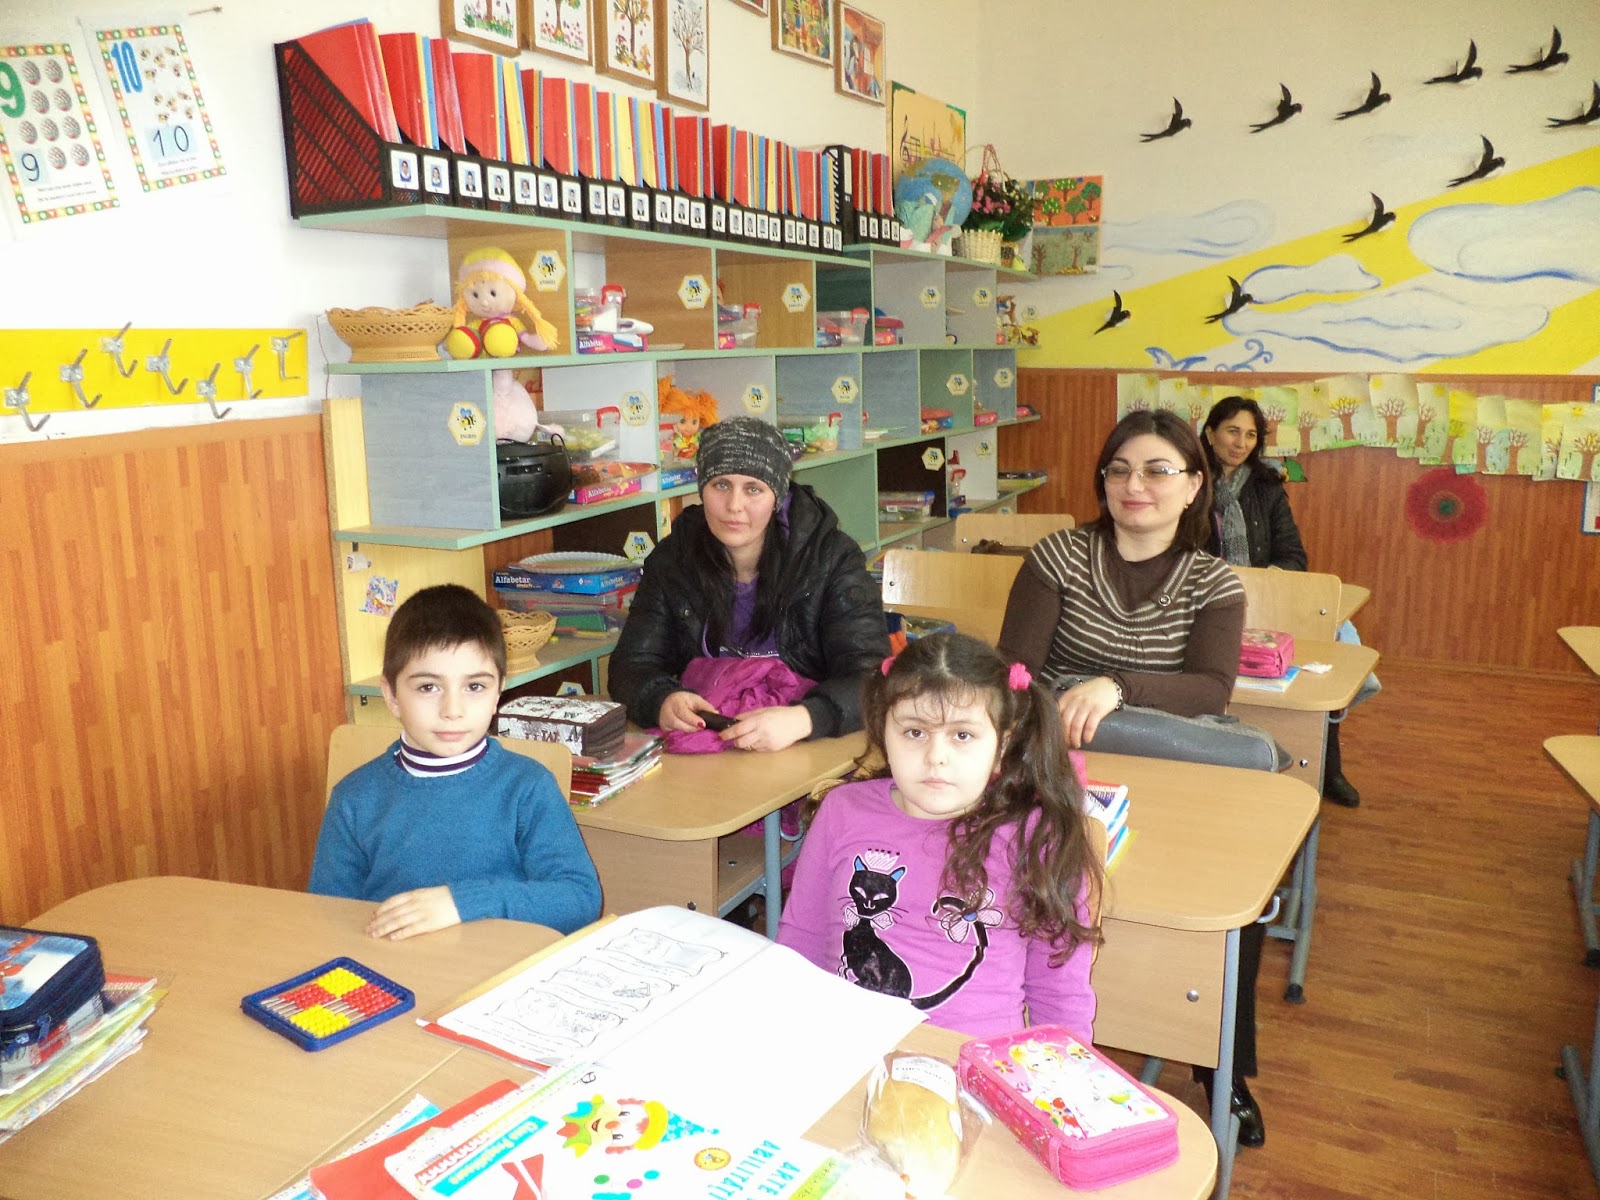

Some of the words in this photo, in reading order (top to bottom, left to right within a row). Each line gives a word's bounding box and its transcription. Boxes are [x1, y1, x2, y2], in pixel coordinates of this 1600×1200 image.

[110, 41, 143, 93] 10
[0, 61, 26, 119] 9
[153, 125, 190, 157] 10
[21, 153, 40, 182] 9
[495, 576, 531, 584] Alfabetar
[758, 1161, 801, 1196] ARTE
